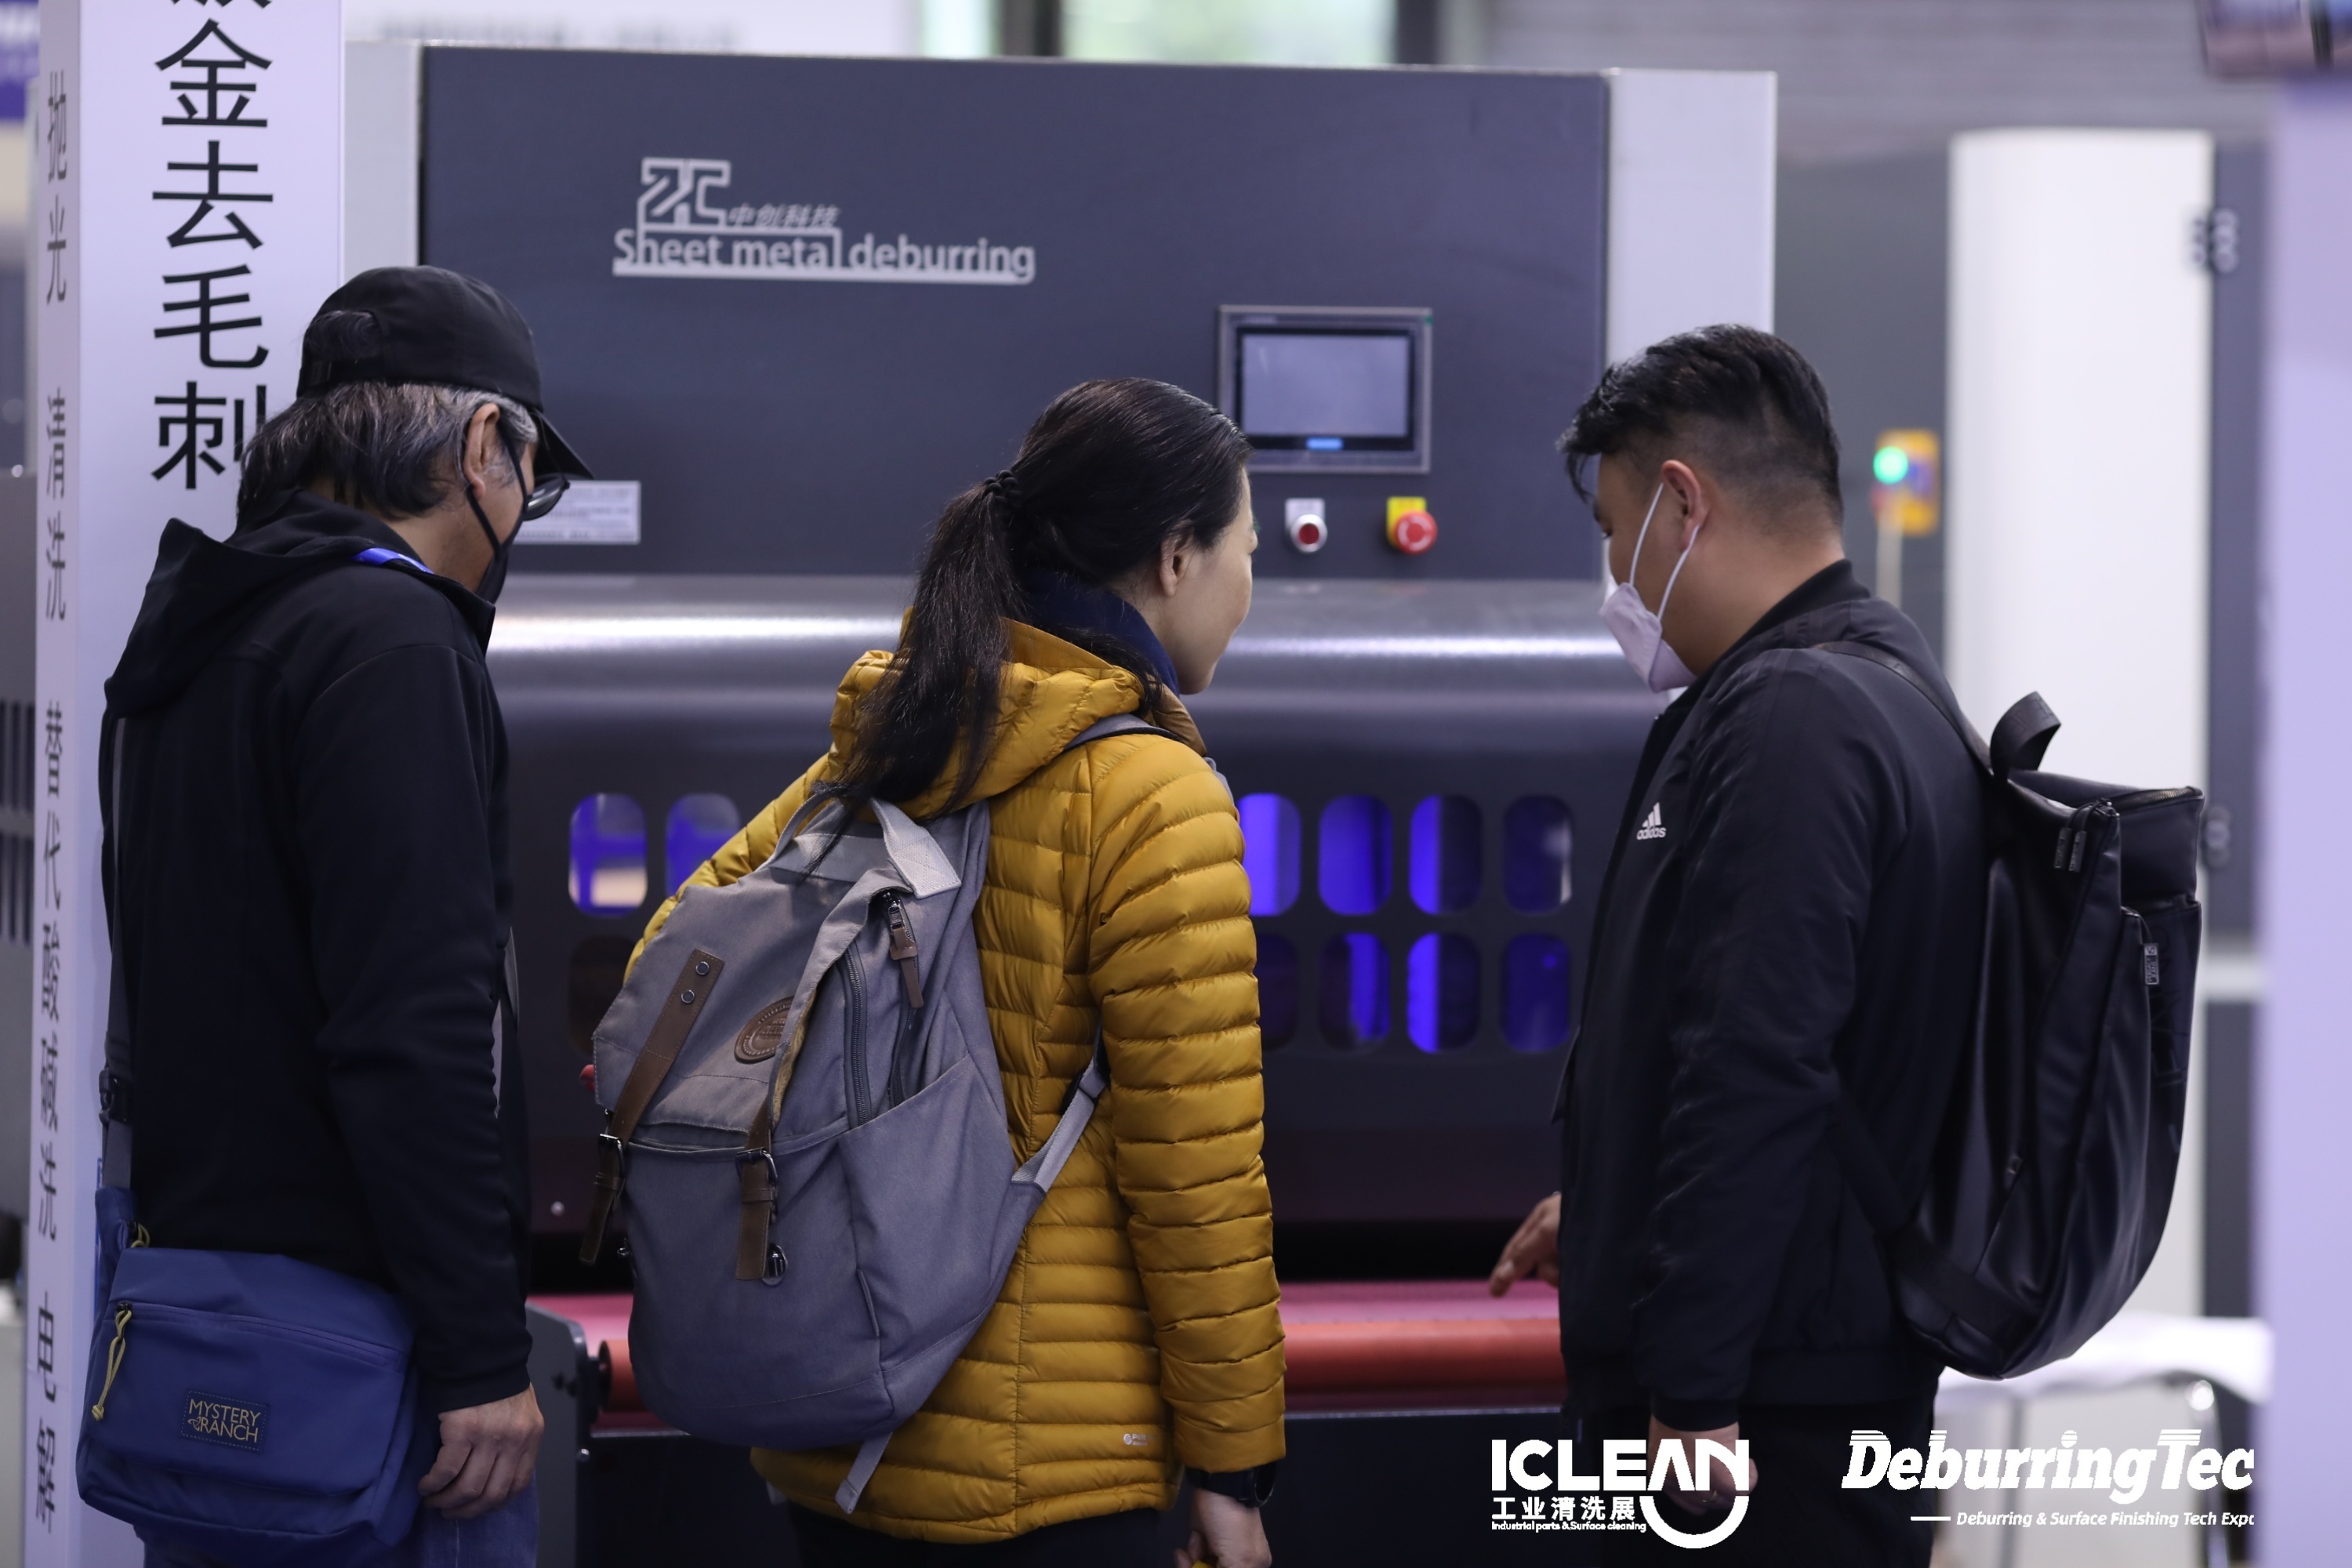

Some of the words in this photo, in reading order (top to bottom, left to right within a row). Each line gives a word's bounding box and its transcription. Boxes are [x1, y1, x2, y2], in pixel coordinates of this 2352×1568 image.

[46, 68, 67, 306] 抛光
[151, 0, 274, 490] 金去毛刺
[614, 228, 724, 269] Sheet
[731, 228, 844, 271] metal
[849, 233, 1036, 284] deburring
[45, 386, 67, 622] 清洗
[1636, 826, 1667, 840] adidas
[34, 1289, 58, 1534] 电解
[188, 1398, 262, 1427] MYSTERY
[200, 1416, 259, 1443] RANCH
